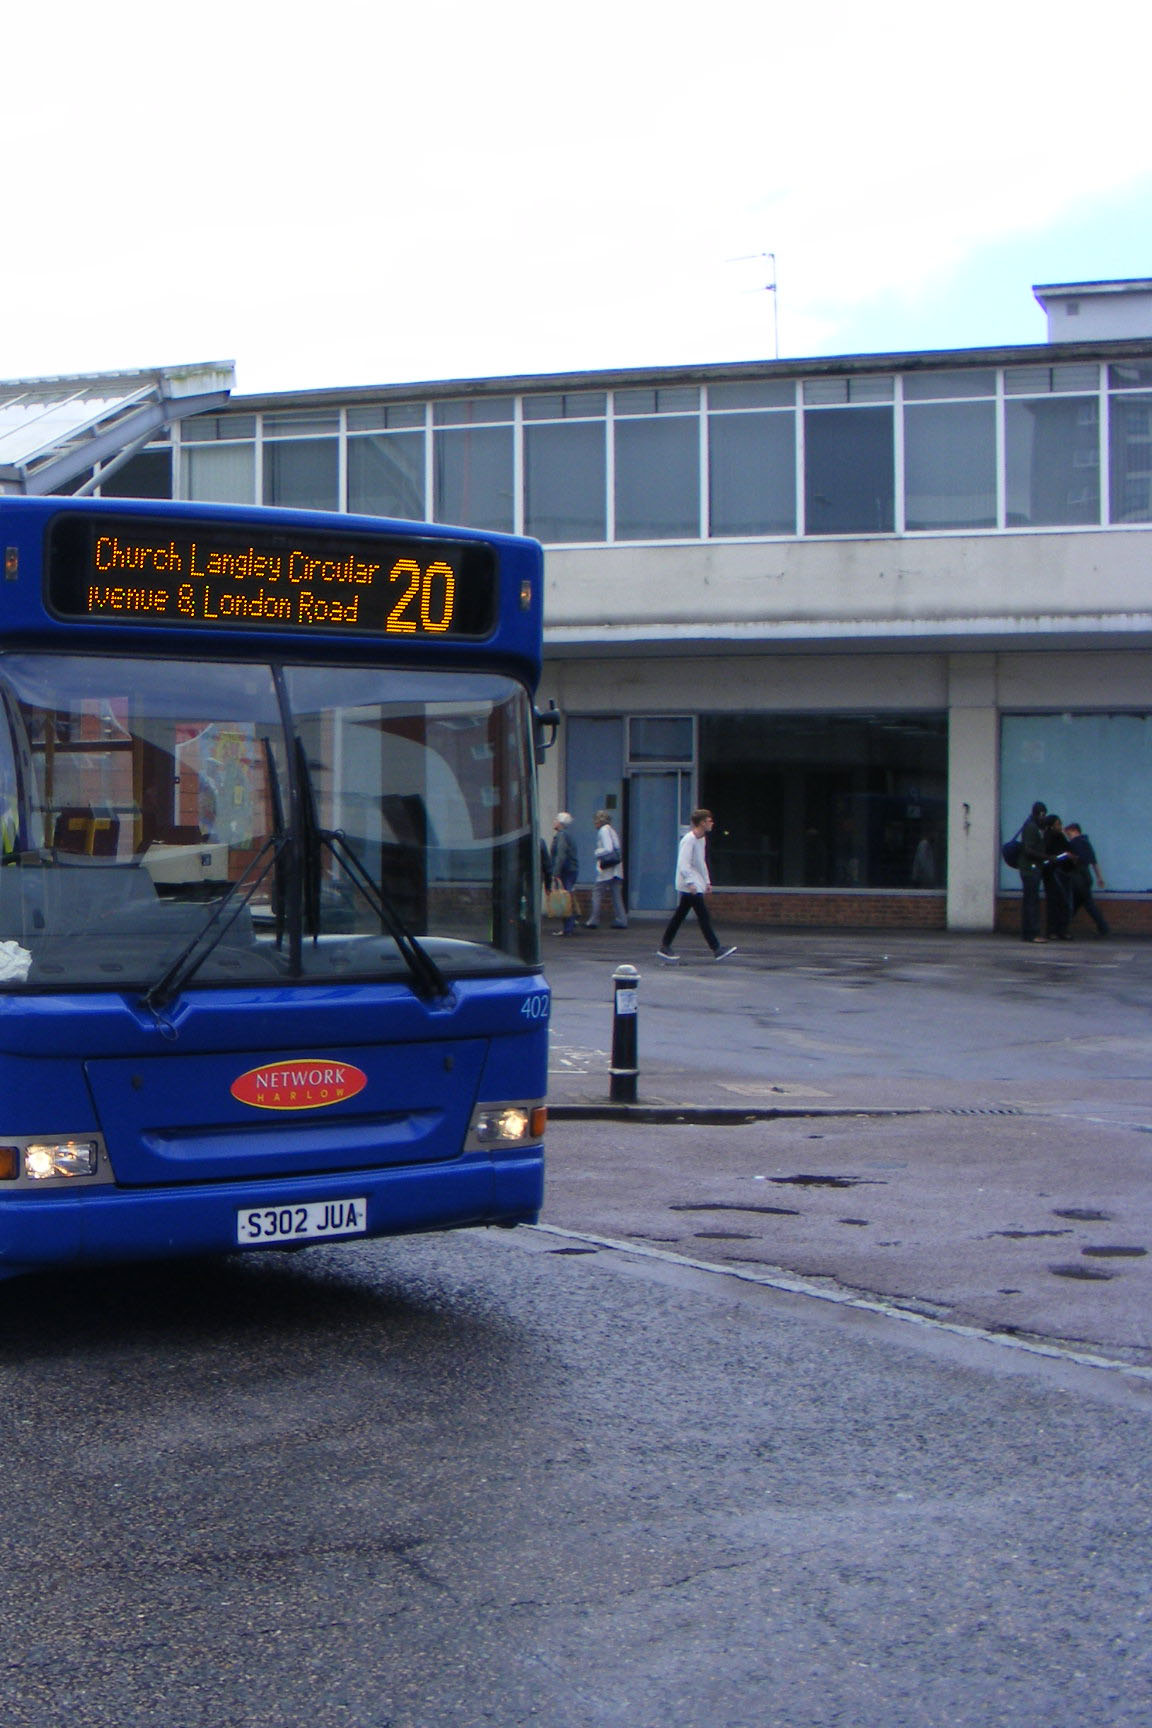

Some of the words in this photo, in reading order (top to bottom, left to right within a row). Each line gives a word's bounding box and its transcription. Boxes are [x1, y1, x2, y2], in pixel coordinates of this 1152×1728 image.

[95, 536, 182, 572] Church
[189, 542, 281, 582] Langley
[288, 549, 380, 585] Circular
[177, 582, 196, 618] &
[203, 585, 291, 619] London
[298, 591, 359, 624] Road
[384, 557, 456, 634] 20
[521, 994, 549, 1019] 402
[256, 1068, 346, 1089] NETWORK
[256, 1088, 346, 1103] HARLOW
[247, 1208, 308, 1238] S302
[316, 1202, 358, 1231] JUA
